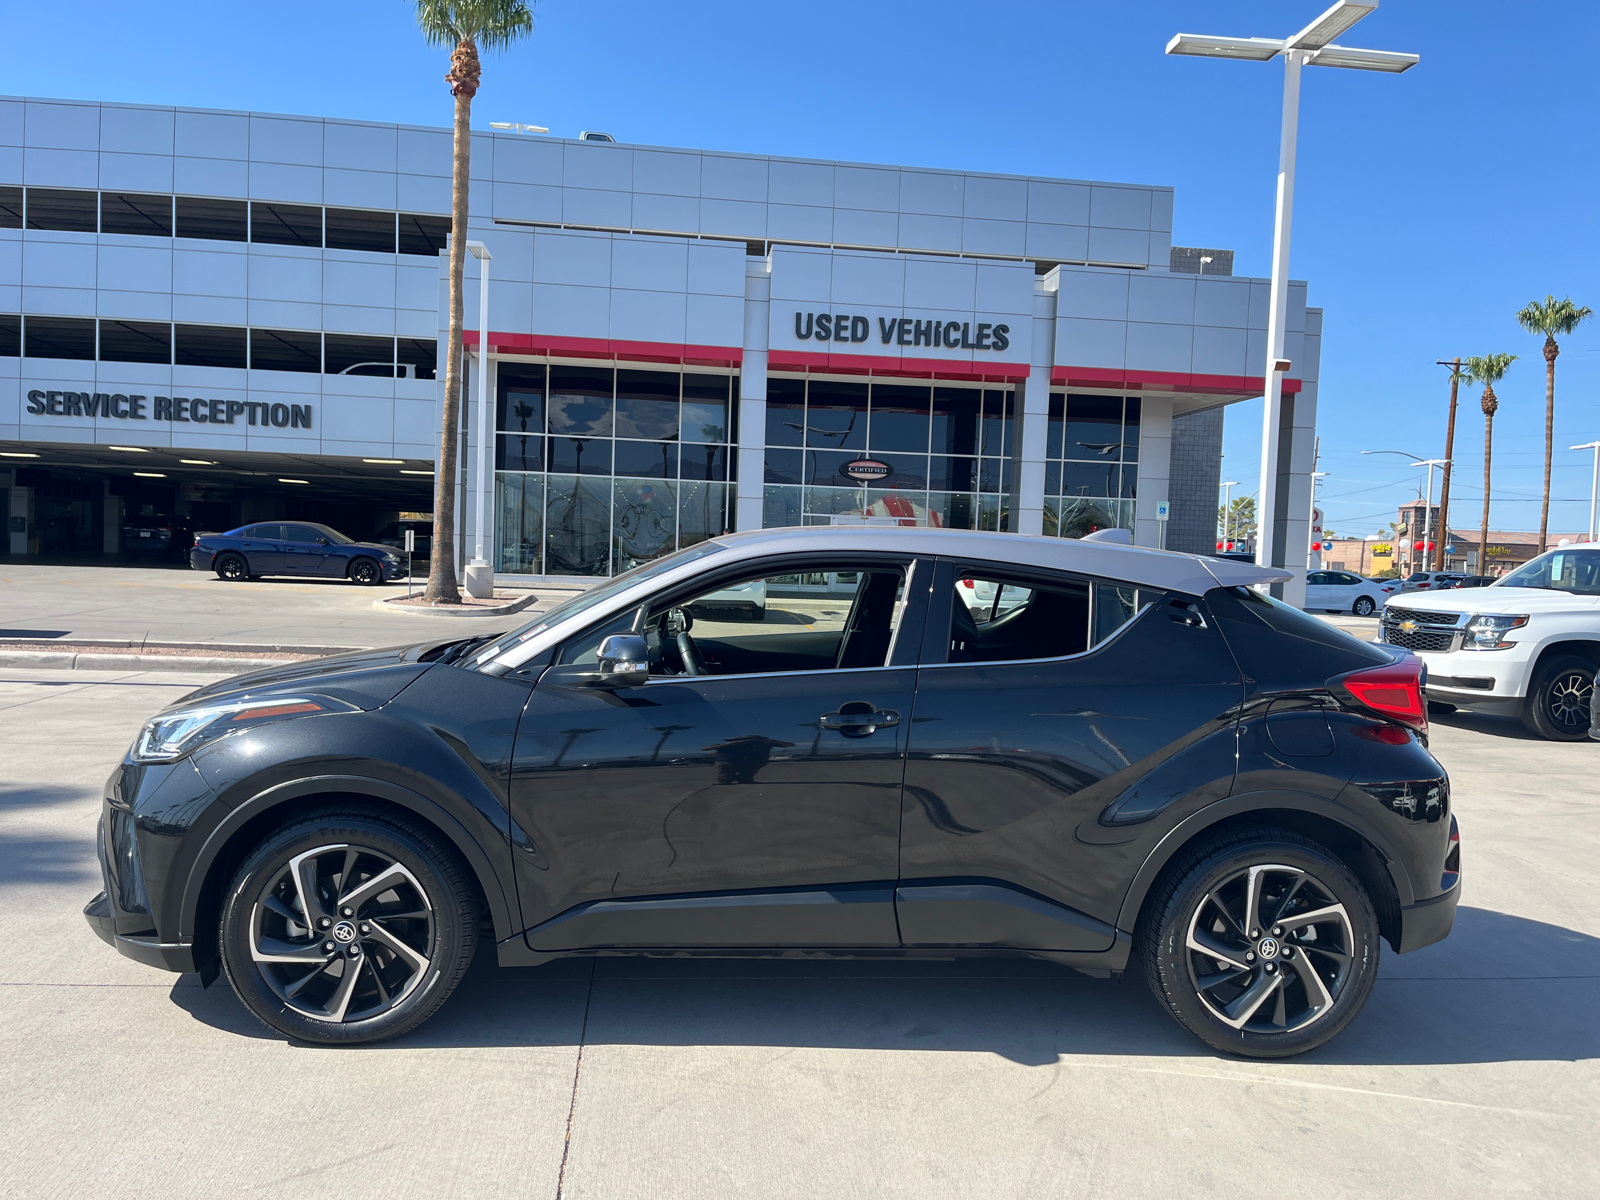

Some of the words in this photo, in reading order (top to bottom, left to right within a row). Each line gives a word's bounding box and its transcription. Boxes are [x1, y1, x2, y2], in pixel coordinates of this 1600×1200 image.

[796, 312, 869, 342] USED
[879, 317, 1009, 351] VEHICLES
[27, 389, 146, 419] SERVICE
[153, 396, 311, 428] RECEPTION
[848, 466, 887, 474] CERTIFIED
